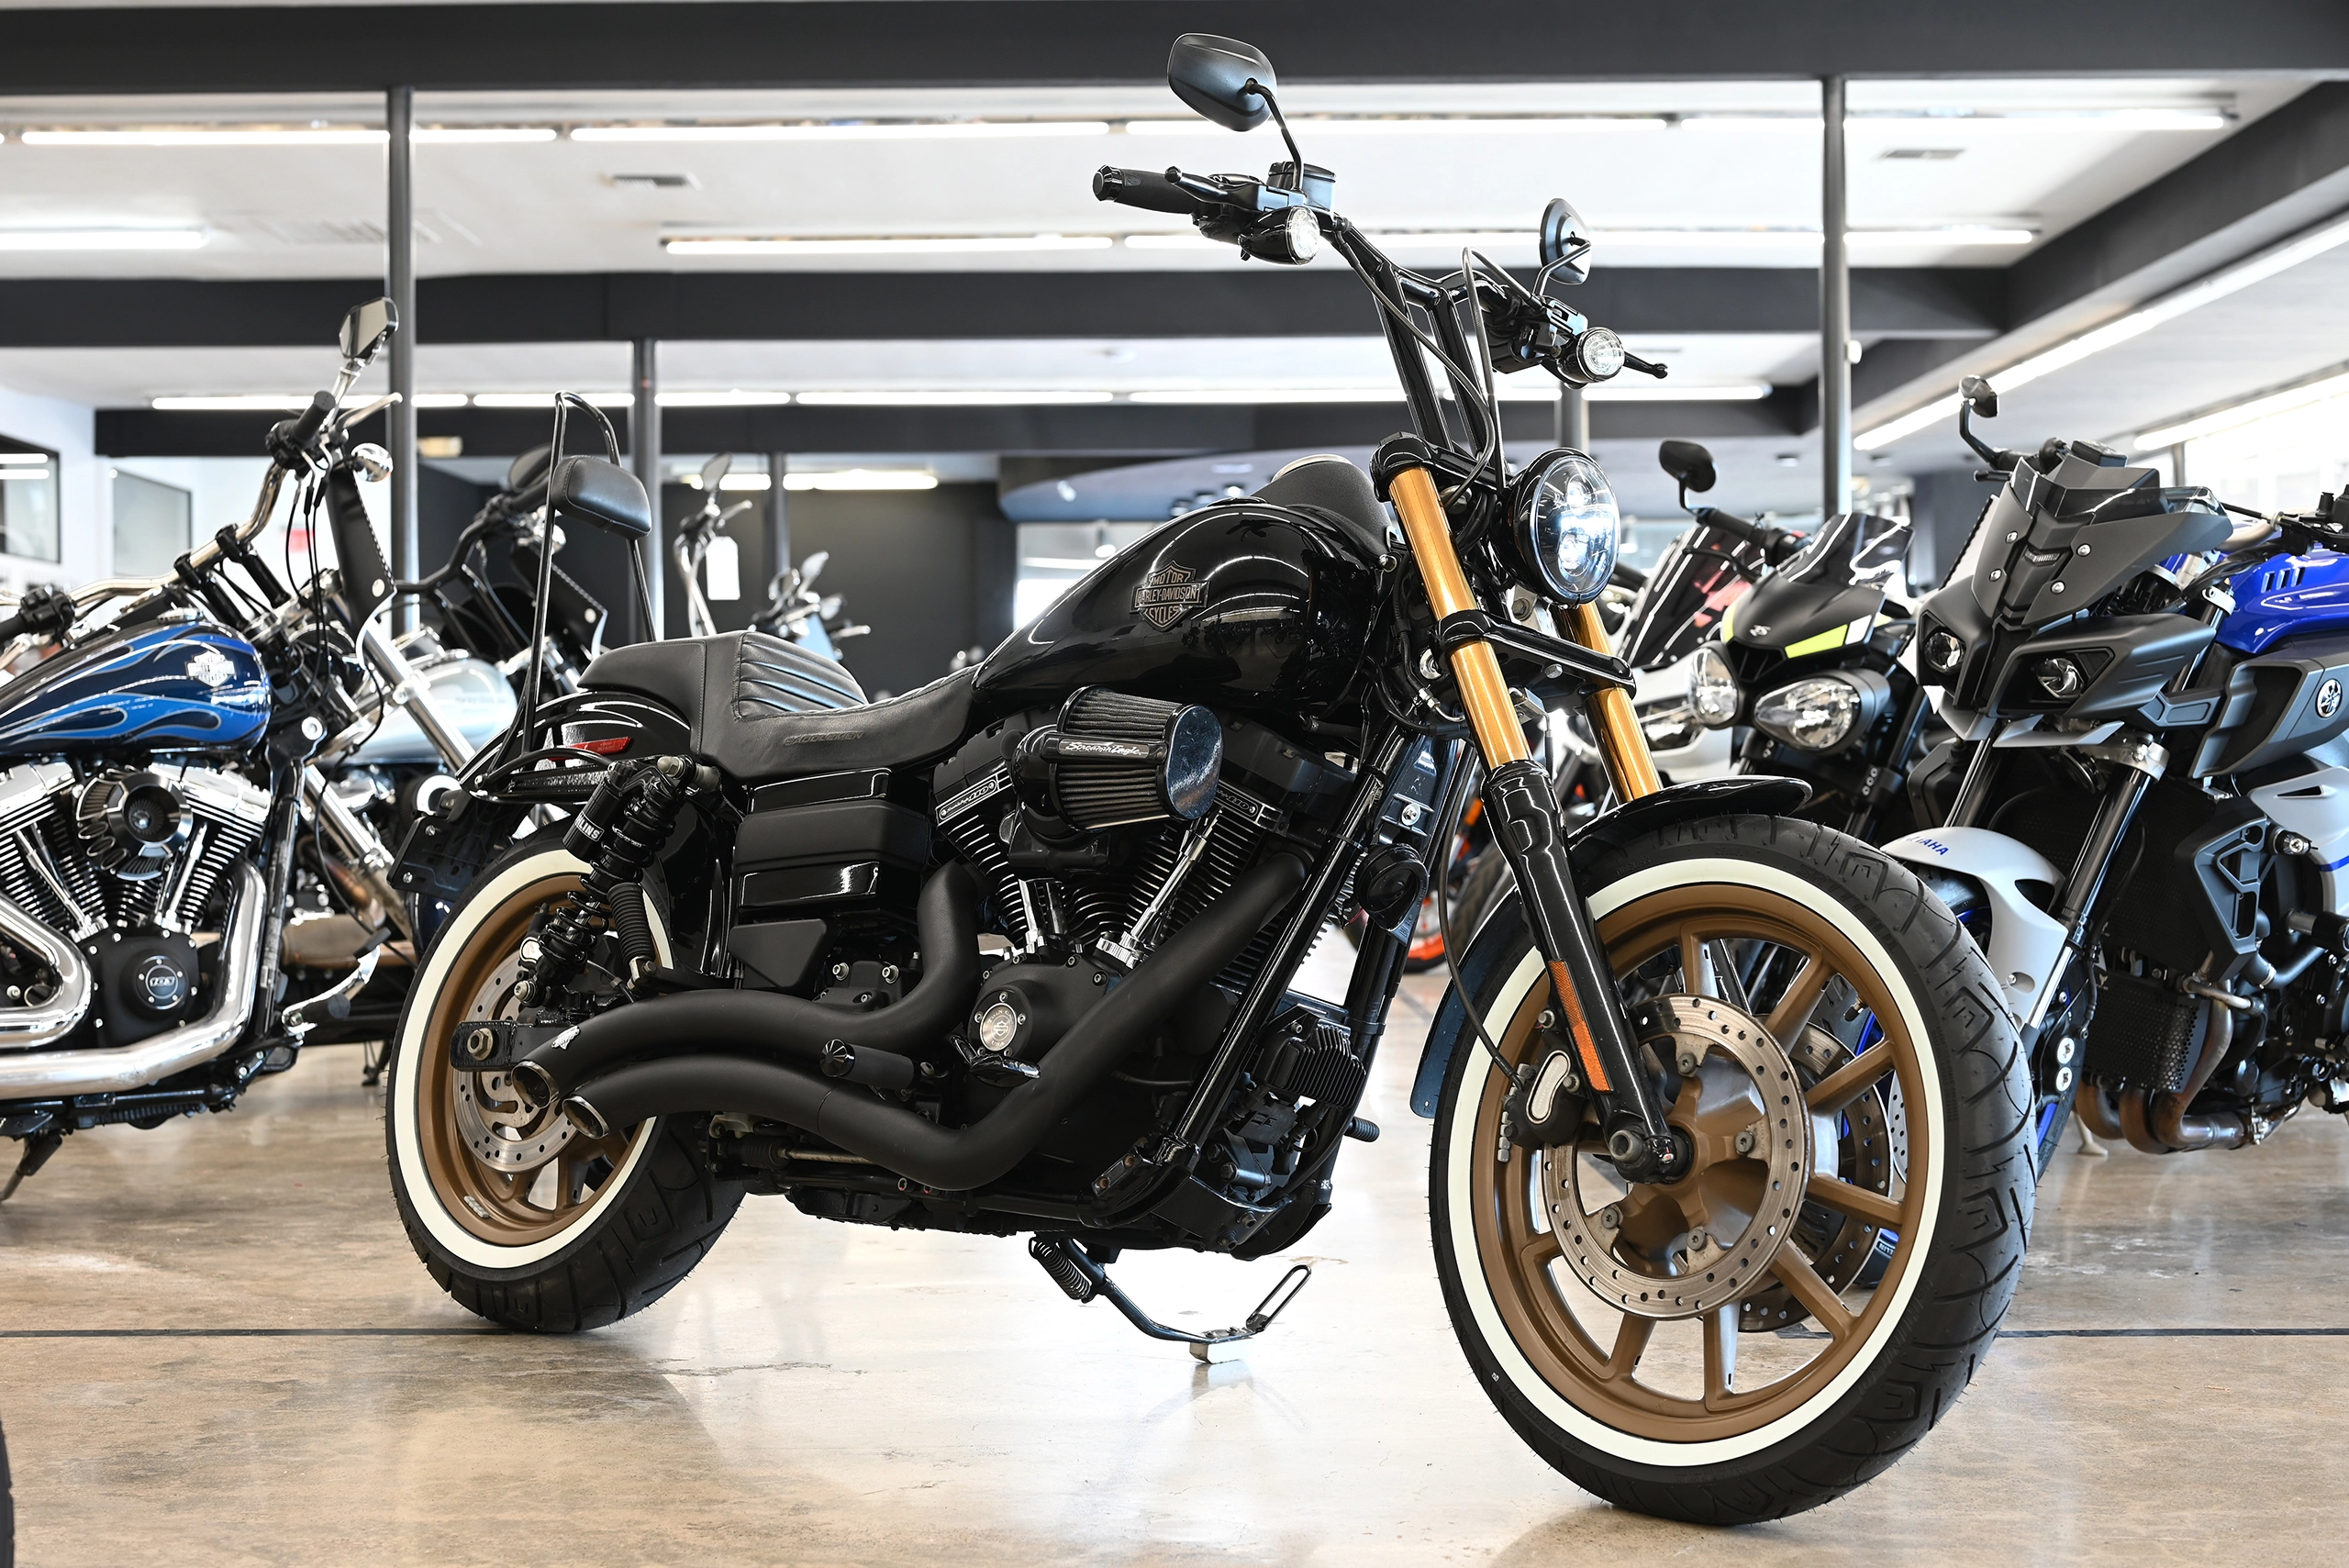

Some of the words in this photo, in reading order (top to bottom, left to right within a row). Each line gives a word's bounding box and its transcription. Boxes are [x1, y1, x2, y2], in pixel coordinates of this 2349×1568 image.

[1152, 569, 1184, 585] MOTOR
[1138, 586, 1197, 605] HARLEY-DAVIDSON
[1149, 606, 1179, 624] CYCLES
[783, 730, 864, 746] SADDLEMEN
